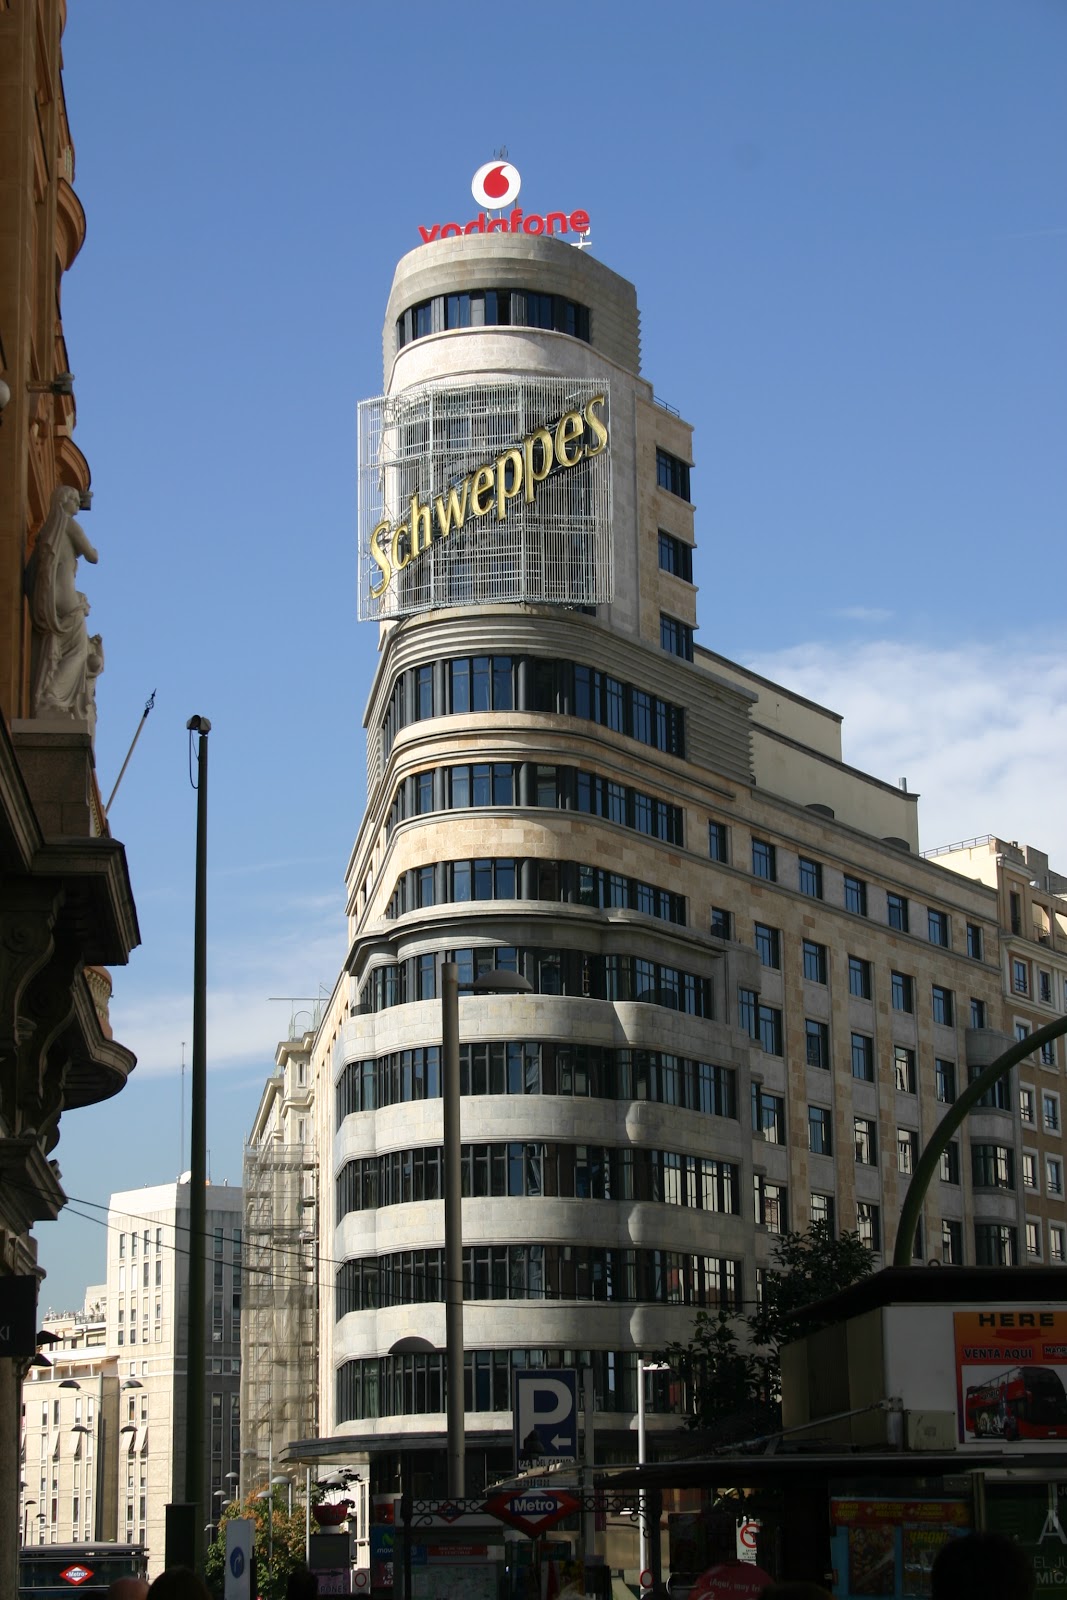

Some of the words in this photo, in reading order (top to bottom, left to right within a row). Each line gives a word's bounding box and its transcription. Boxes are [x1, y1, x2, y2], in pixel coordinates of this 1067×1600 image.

[419, 208, 591, 243] vodafone
[369, 395, 609, 599] Schweppes
[979, 1313, 1054, 1327] HERE
[964, 1348, 1000, 1359] VENTA
[1004, 1348, 1032, 1359] AQUI
[519, 1378, 573, 1450] P
[514, 1498, 555, 1512] Metro
[1033, 1556, 1050, 1568] EL
